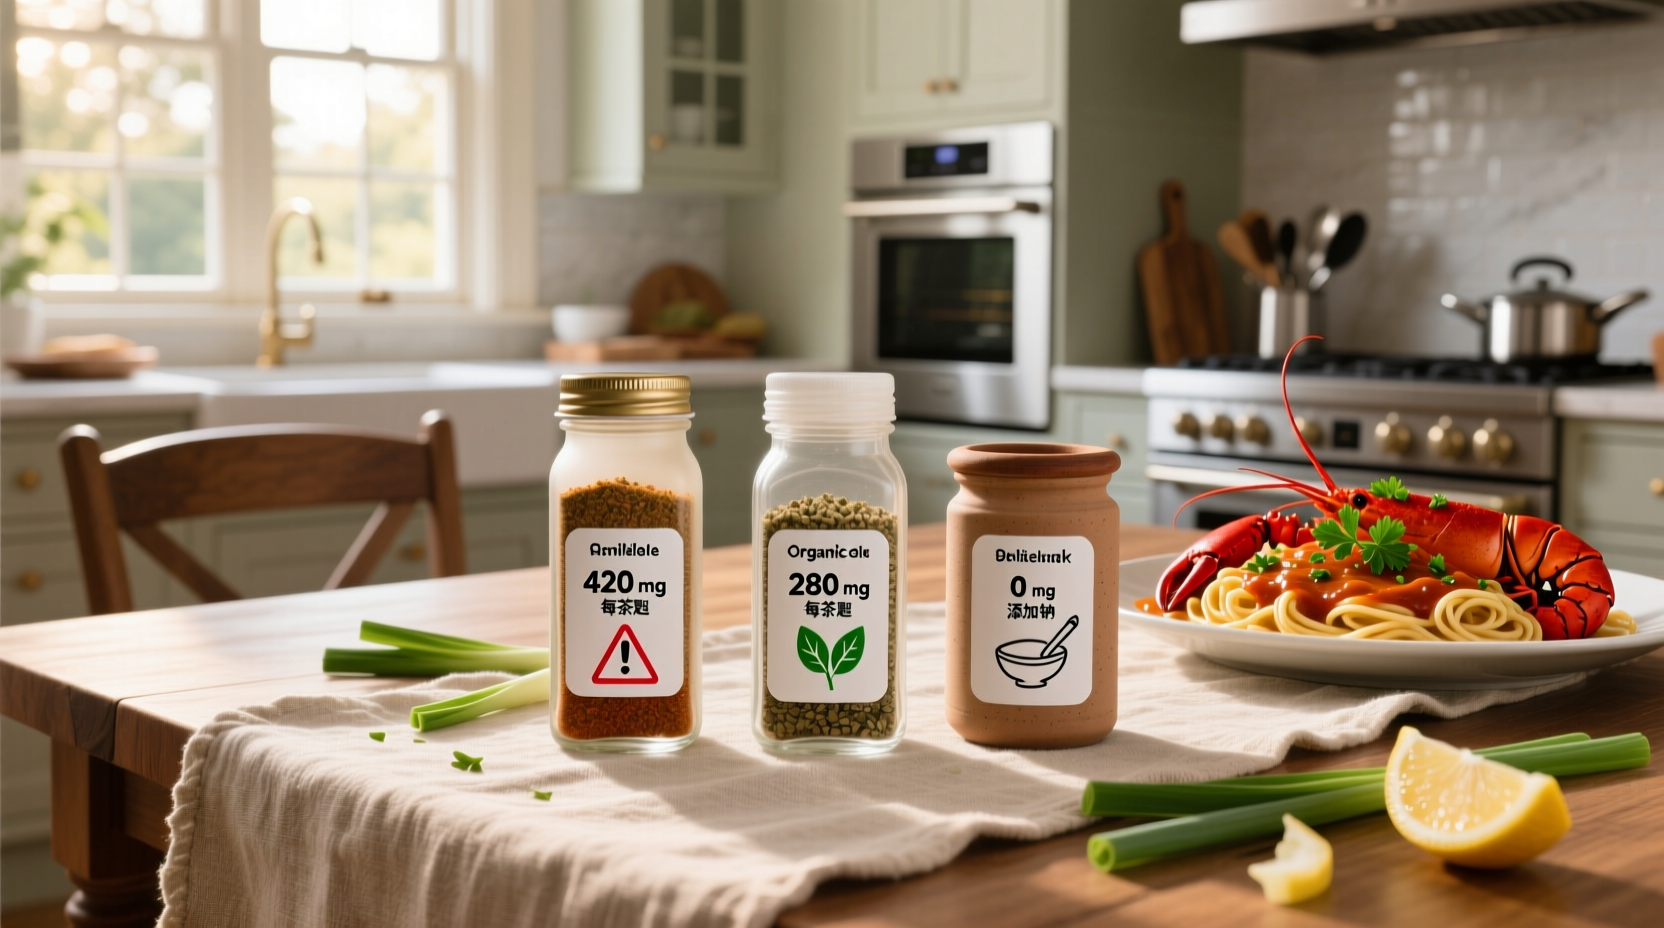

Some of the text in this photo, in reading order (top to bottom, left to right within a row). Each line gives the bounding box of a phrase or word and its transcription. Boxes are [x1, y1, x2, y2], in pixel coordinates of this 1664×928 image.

[583, 570, 666, 597] 420 mg
[789, 573, 869, 600] 280 mg
[1010, 576, 1055, 600] 0 mg
